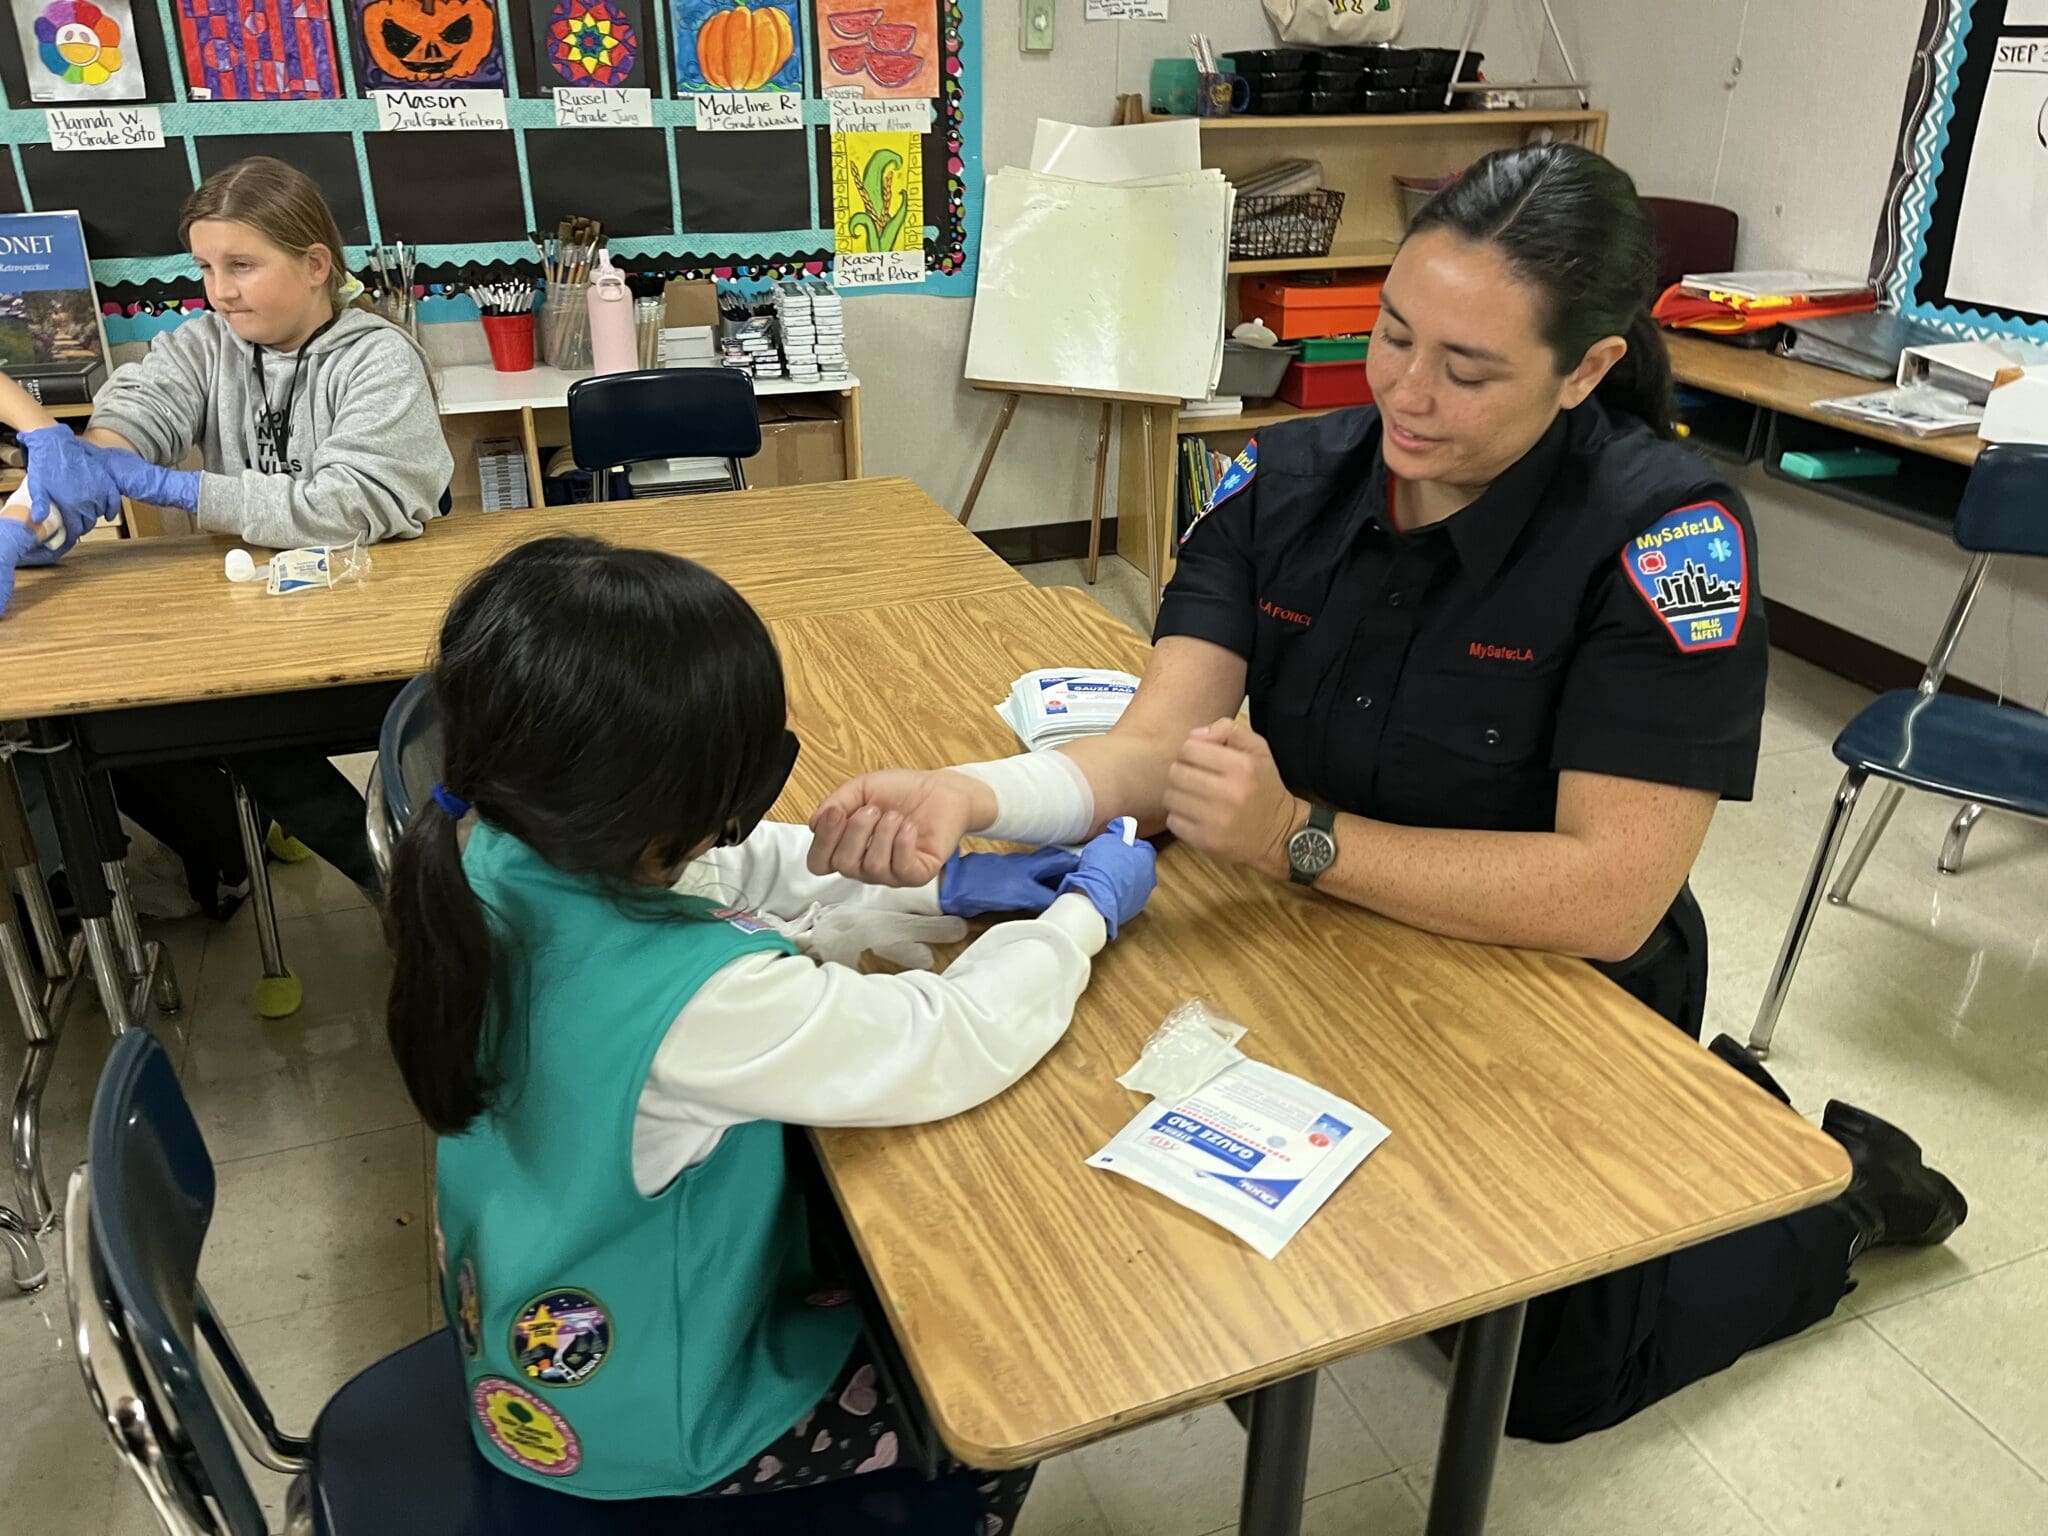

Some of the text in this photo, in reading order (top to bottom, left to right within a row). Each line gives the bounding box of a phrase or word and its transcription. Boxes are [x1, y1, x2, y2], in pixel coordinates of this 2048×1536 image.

[1998, 43, 2038, 64] STEP
[386, 92, 467, 109] Mason
[558, 89, 629, 106] Russel Y.
[698, 94, 796, 116] Madeline R.
[575, 107, 607, 123] Grade
[832, 101, 910, 116] Sebastian
[51, 109, 142, 130] Hannah W.
[722, 116, 755, 129] Grade
[836, 116, 878, 132] Kinder
[78, 130, 119, 147] Grade
[121, 125, 156, 145] Soto
[841, 255, 884, 268] Kasey
[853, 267, 885, 283] Grade
[1636, 515, 1725, 550] MySafe:LA
[1690, 617, 1721, 632] PUBLIC
[1691, 627, 1723, 642] SAFETY
[1468, 642, 1534, 662] MySafe:LA
[1167, 1115, 1201, 1134] PAD
[1198, 1128, 1256, 1160] GAUZE
